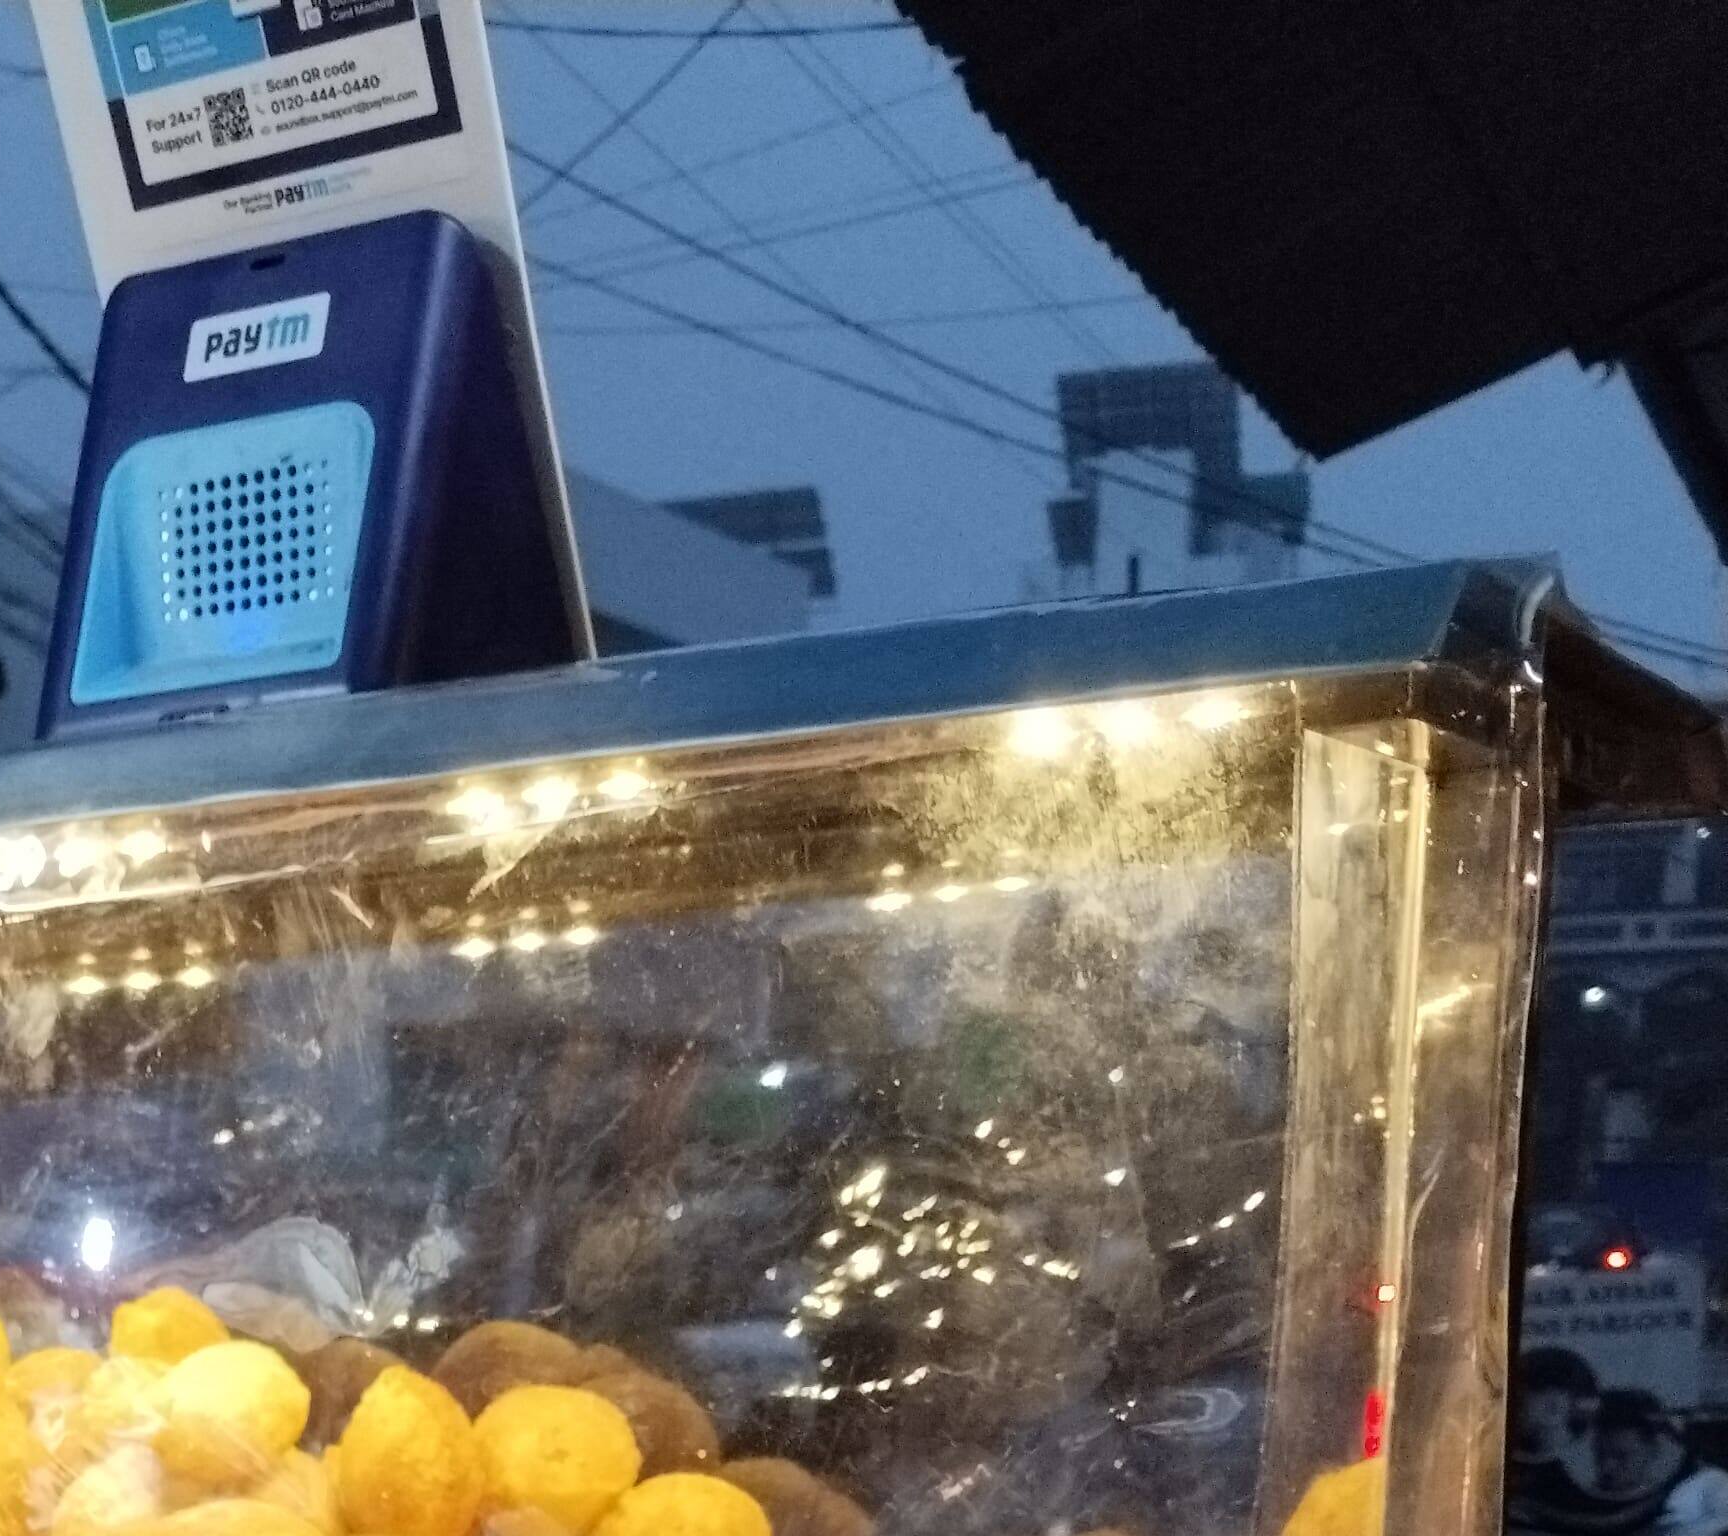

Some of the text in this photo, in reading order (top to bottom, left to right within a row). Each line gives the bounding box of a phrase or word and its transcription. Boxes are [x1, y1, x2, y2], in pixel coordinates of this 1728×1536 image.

[266, 58, 357, 93] Scan QR code
[271, 75, 381, 115] 0120-444-0440
[146, 117, 167, 134] For
[152, 130, 204, 154] Support
